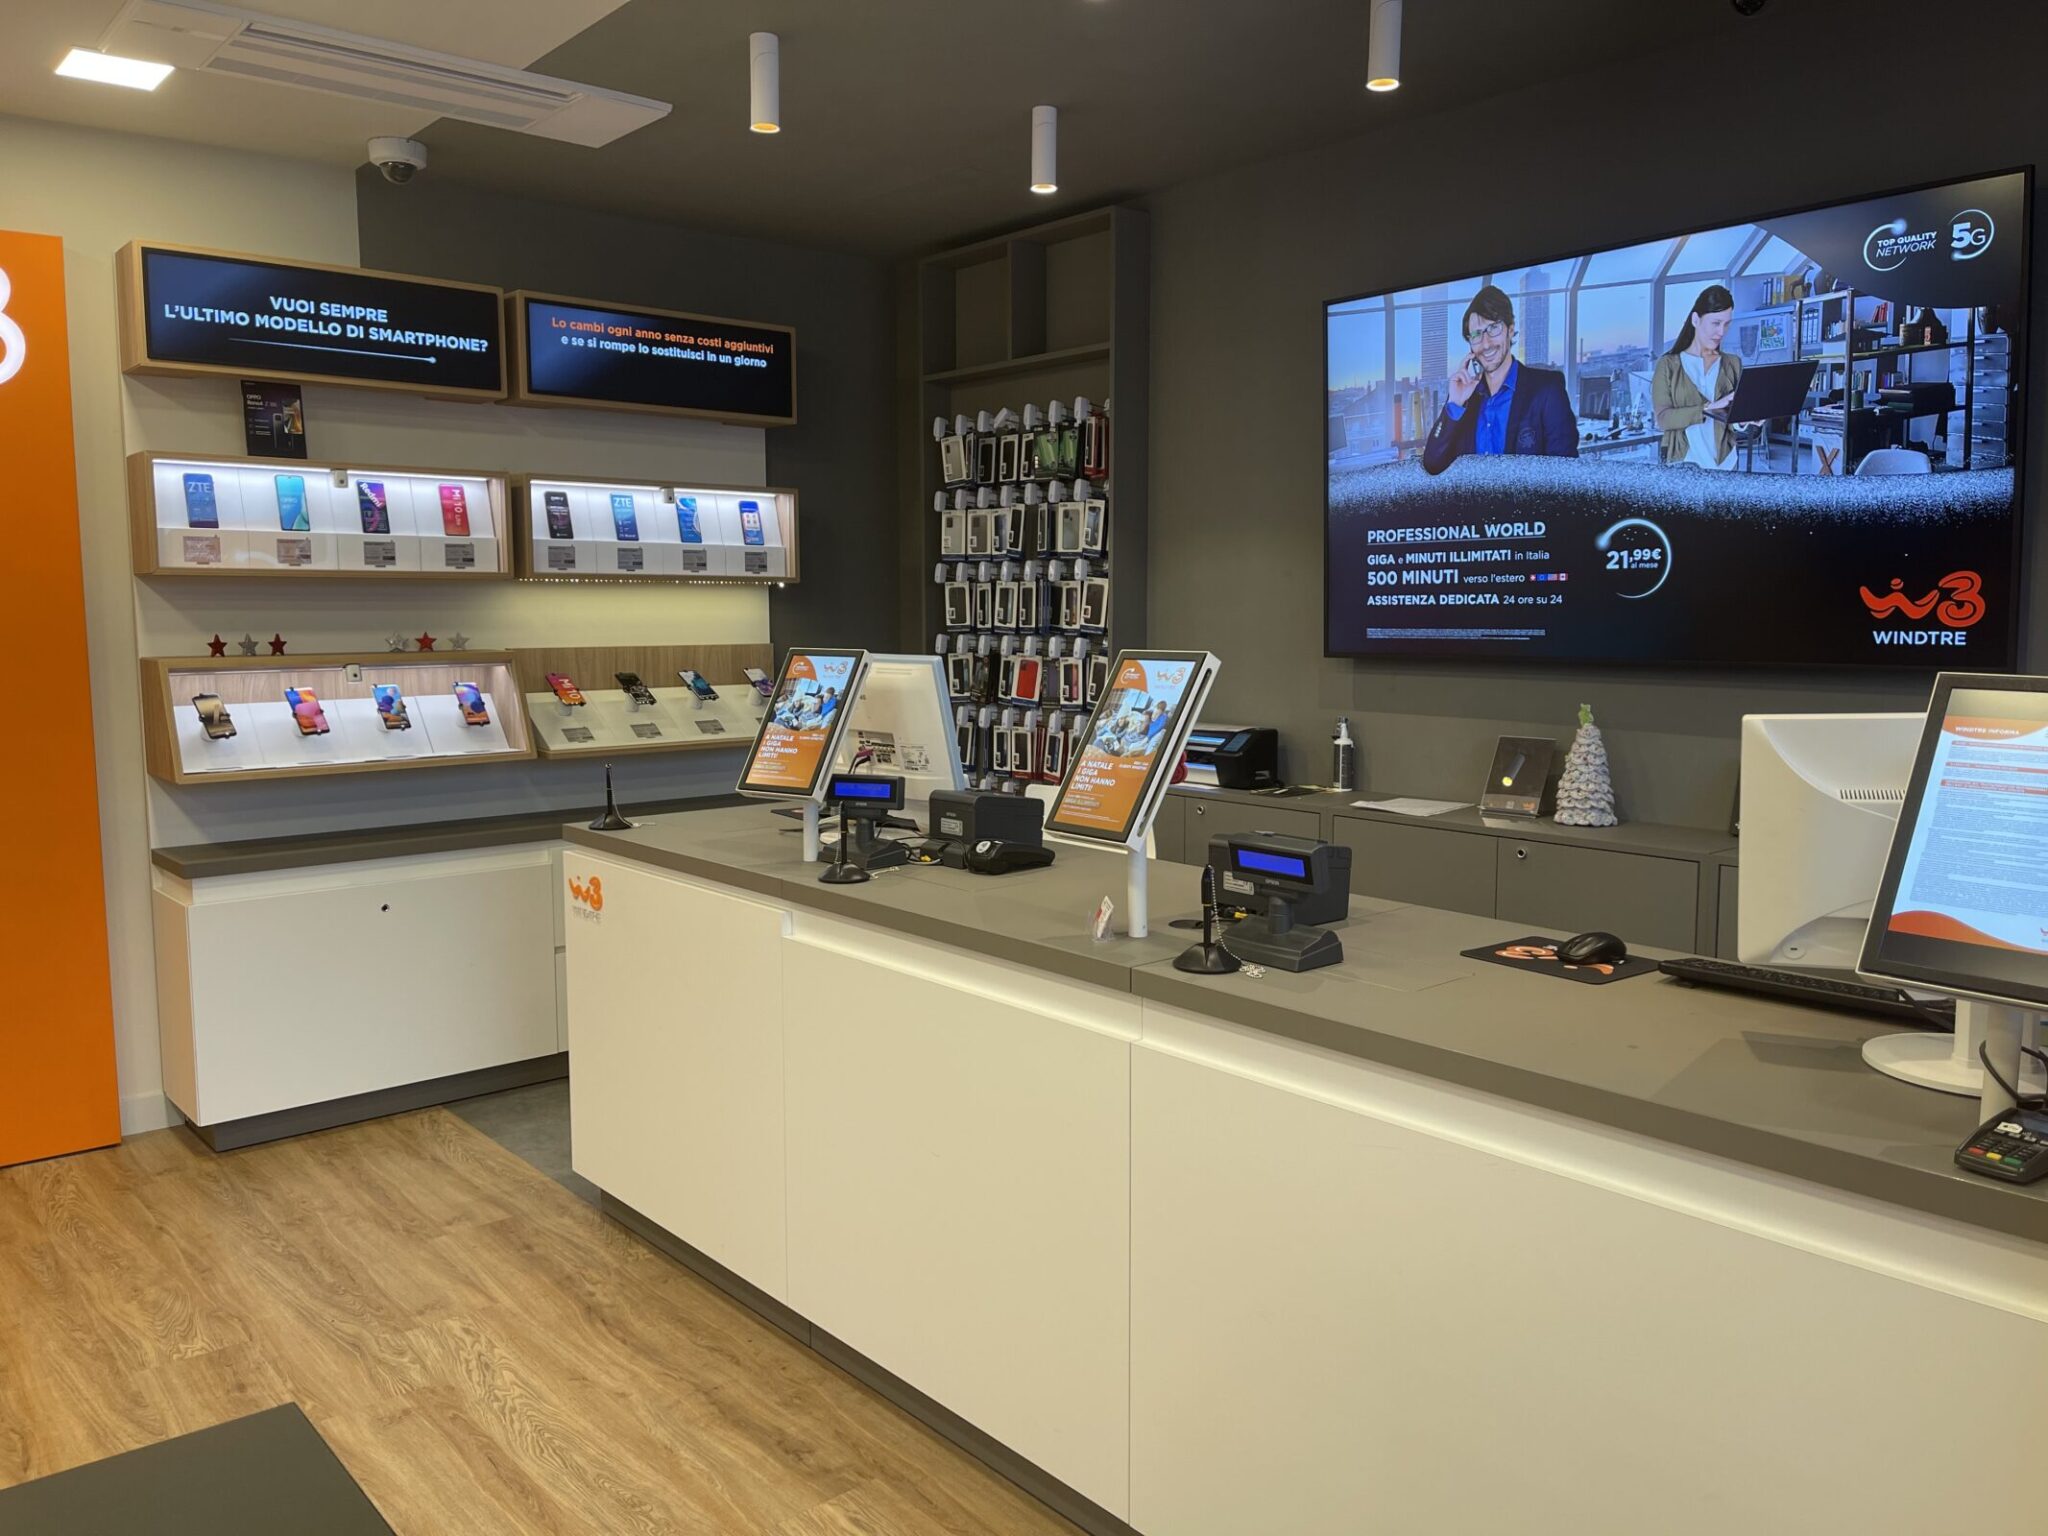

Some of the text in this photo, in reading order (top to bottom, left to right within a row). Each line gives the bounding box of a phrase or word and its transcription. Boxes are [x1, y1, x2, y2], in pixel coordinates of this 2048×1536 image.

[1877, 231, 1938, 248] TOP QUALITY
[1950, 222, 1986, 248] 5G
[1875, 239, 1936, 258] NETWORK
[269, 296, 388, 323] VUOI SEMPRE
[164, 303, 488, 352] L'ULTIMO MODELLO DI SMARTPHONE?
[552, 317, 774, 355] Lo cambi ogni anno senza costi aggiuntivi
[561, 334, 767, 368] e se si rompe lo sostituisci in un giorno
[188, 481, 212, 493] ZTE
[360, 482, 383, 508] Redmi
[454, 502, 463, 513] 10
[613, 497, 632, 508] ZTE
[1367, 521, 1546, 543] PROFESSIONAL WORLD
[1367, 549, 1550, 565] GIGA e MINUTI ILLIMITATI in Italia
[1606, 548, 1662, 569] 21,99€
[1367, 569, 1525, 585] 500 MINUTI verso l'estero
[1367, 594, 1563, 606] ASSISTENZA DEDICATA 24 ore su 24
[1872, 630, 1967, 646] WINDTRE
[1081, 768, 1098, 776] GIGA
[1087, 761, 1114, 770] NATALE
[1075, 775, 1116, 786] NON HANNO
